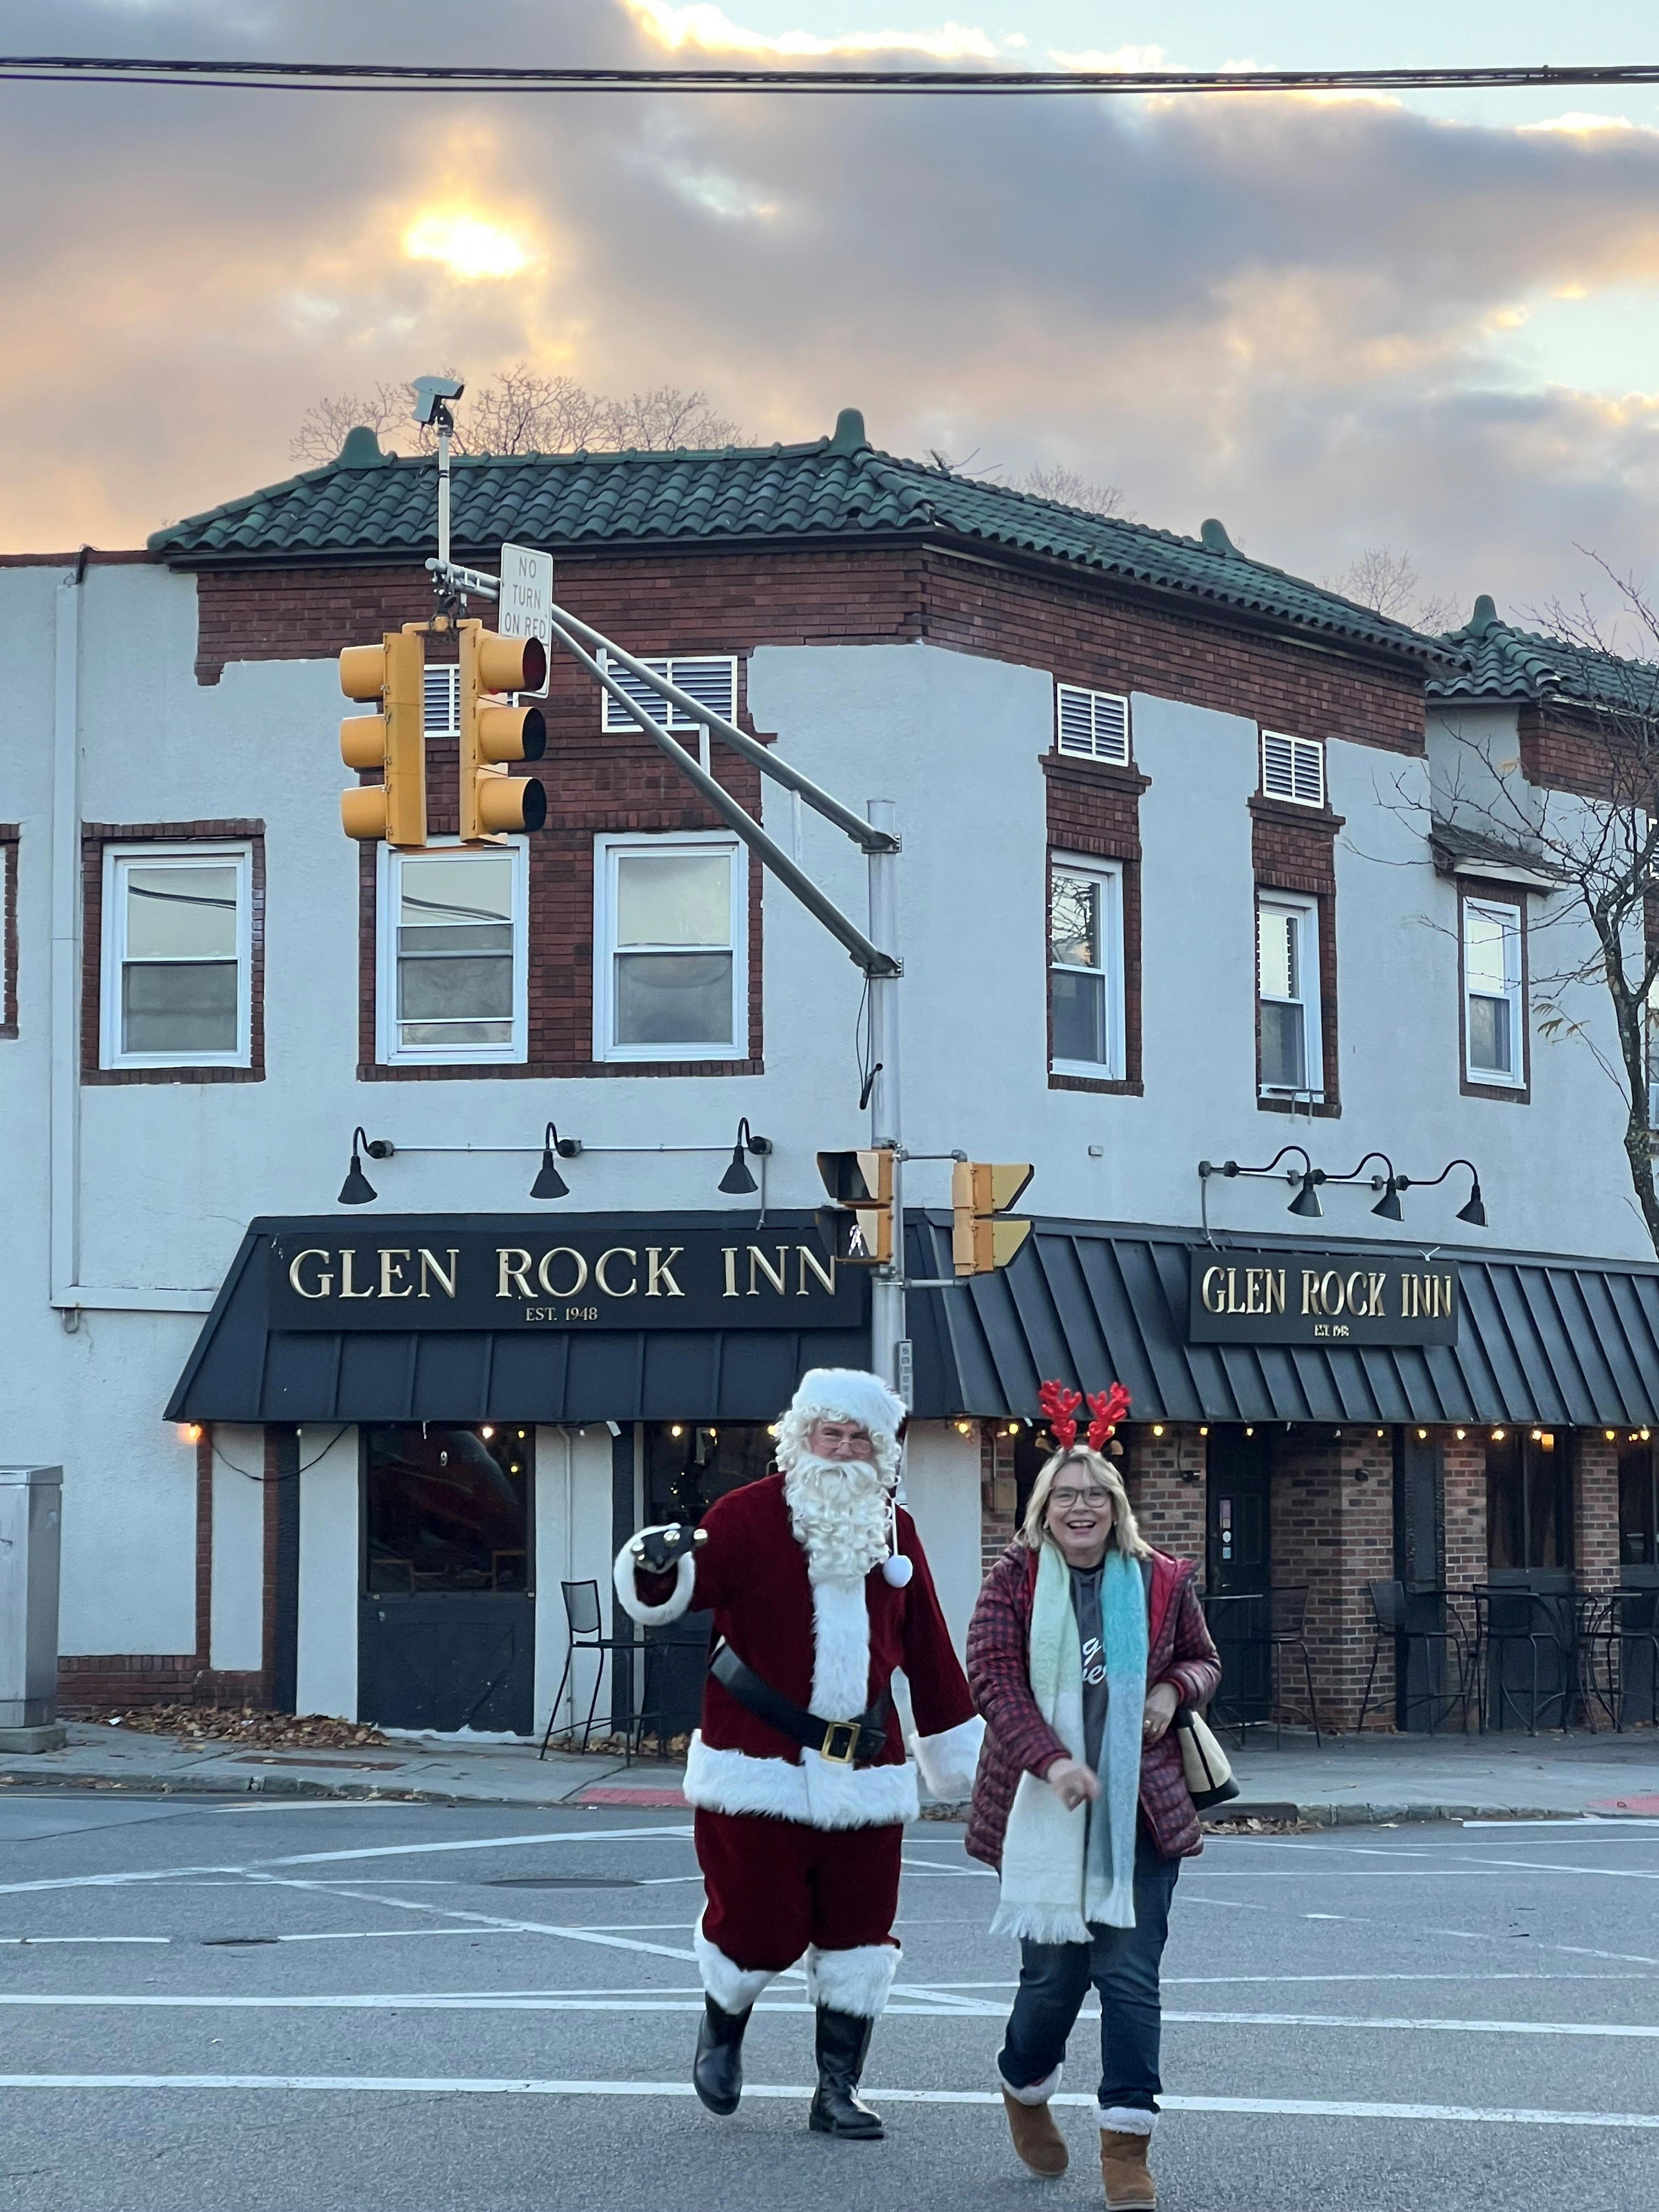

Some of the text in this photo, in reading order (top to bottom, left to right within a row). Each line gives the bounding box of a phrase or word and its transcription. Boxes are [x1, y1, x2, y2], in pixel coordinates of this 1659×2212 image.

[518, 556, 537, 579] NO
[513, 583, 541, 610] TURN
[504, 612, 546, 640] ON RED
[289, 1245, 836, 1300] GLEN ROCK INN
[1202, 1266, 1451, 1318] GLEN ROCK INN
[526, 1307, 597, 1321] EST. 1948
